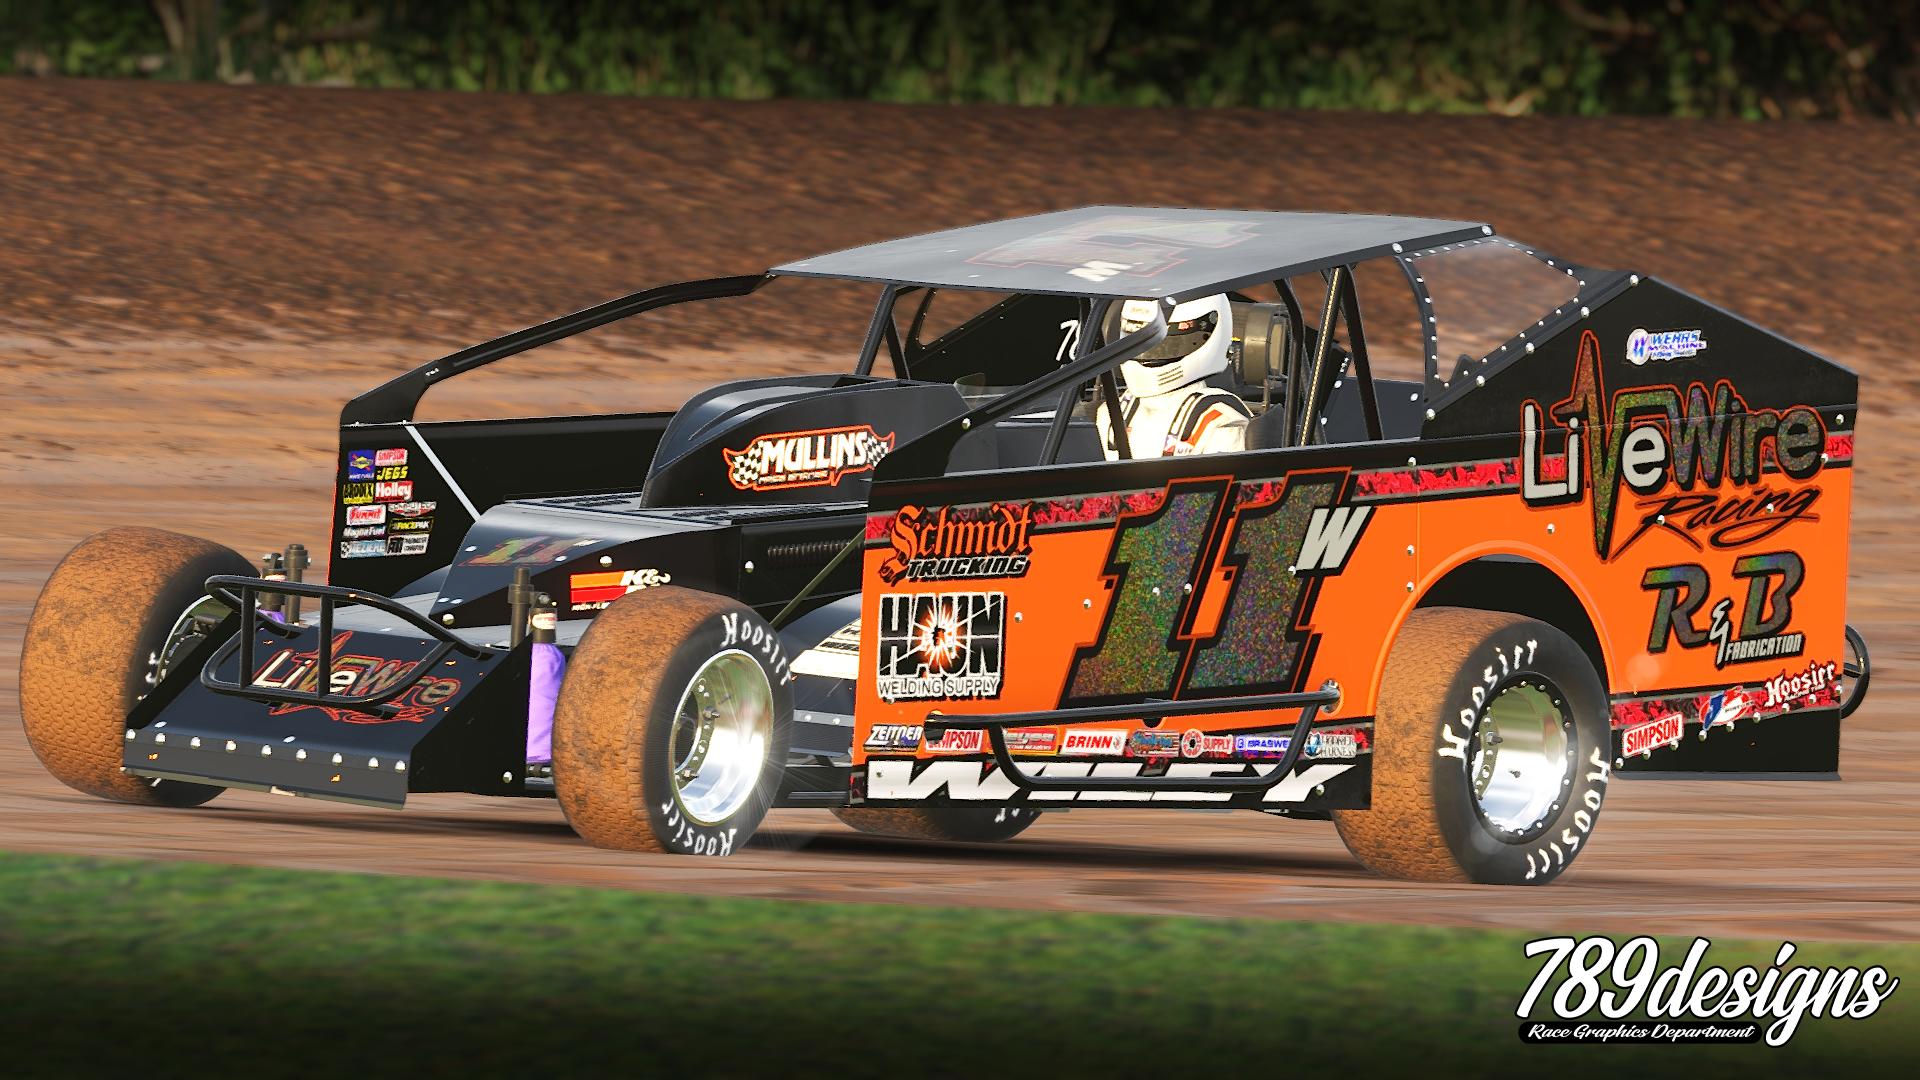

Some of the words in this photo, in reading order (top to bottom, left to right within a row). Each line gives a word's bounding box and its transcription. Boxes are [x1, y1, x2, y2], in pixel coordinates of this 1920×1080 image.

[377, 450, 405, 460] SIMPSON
[760, 431, 868, 474] MULLINS
[376, 466, 408, 480] JEGS
[375, 481, 414, 500] Holley
[1600, 487, 1822, 561] Racing
[880, 504, 1033, 586] Schmidt
[906, 555, 1030, 580] TRUCKING
[879, 592, 1004, 677] HAUN
[1724, 633, 1804, 662] FABRICATION
[879, 681, 942, 697] WELDING
[946, 679, 1000, 695] SUPPLY
[1764, 661, 1836, 708] Hoosier
[928, 729, 981, 749] MPSON
[1065, 735, 1113, 749] BRINN
[1203, 736, 1233, 749] SUPPLY
[1247, 739, 1290, 749] BRASWE
[1626, 719, 1680, 753] SIMPSON
